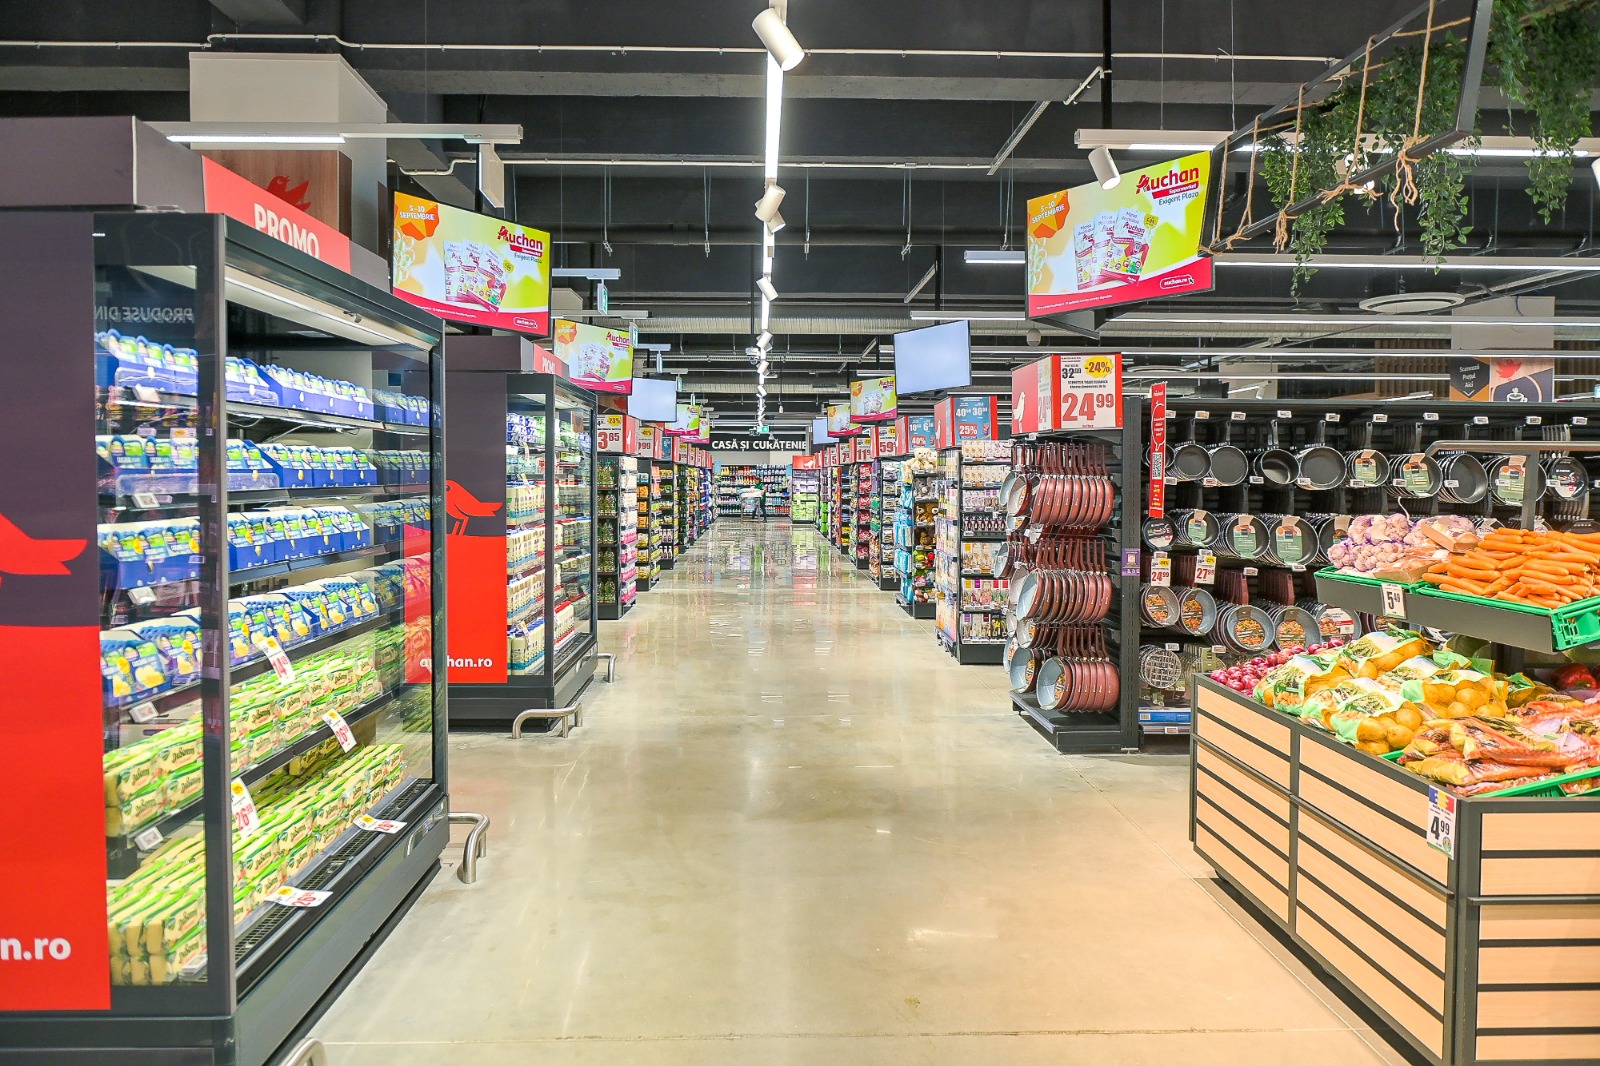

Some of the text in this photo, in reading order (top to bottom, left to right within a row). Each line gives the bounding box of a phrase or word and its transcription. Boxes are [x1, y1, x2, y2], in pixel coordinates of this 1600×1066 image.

[1136, 167, 1199, 195] Auchan
[1158, 191, 1199, 206] Exigent Plaza
[399, 211, 435, 221] SEPTEMBRIE
[1031, 203, 1066, 224] SEPTEMBRIE
[254, 202, 319, 260] PROMO
[497, 225, 543, 251] Auchan
[1084, 361, 1111, 374] -24%
[1062, 392, 1115, 422] 2499
[959, 425, 978, 435] 25%
[711, 438, 807, 452] CASĂ ȘI CURĂȚENIE
[419, 654, 493, 668] ahan.ro
[1430, 815, 1451, 841] 499
[0, 937, 72, 961] n.ro
